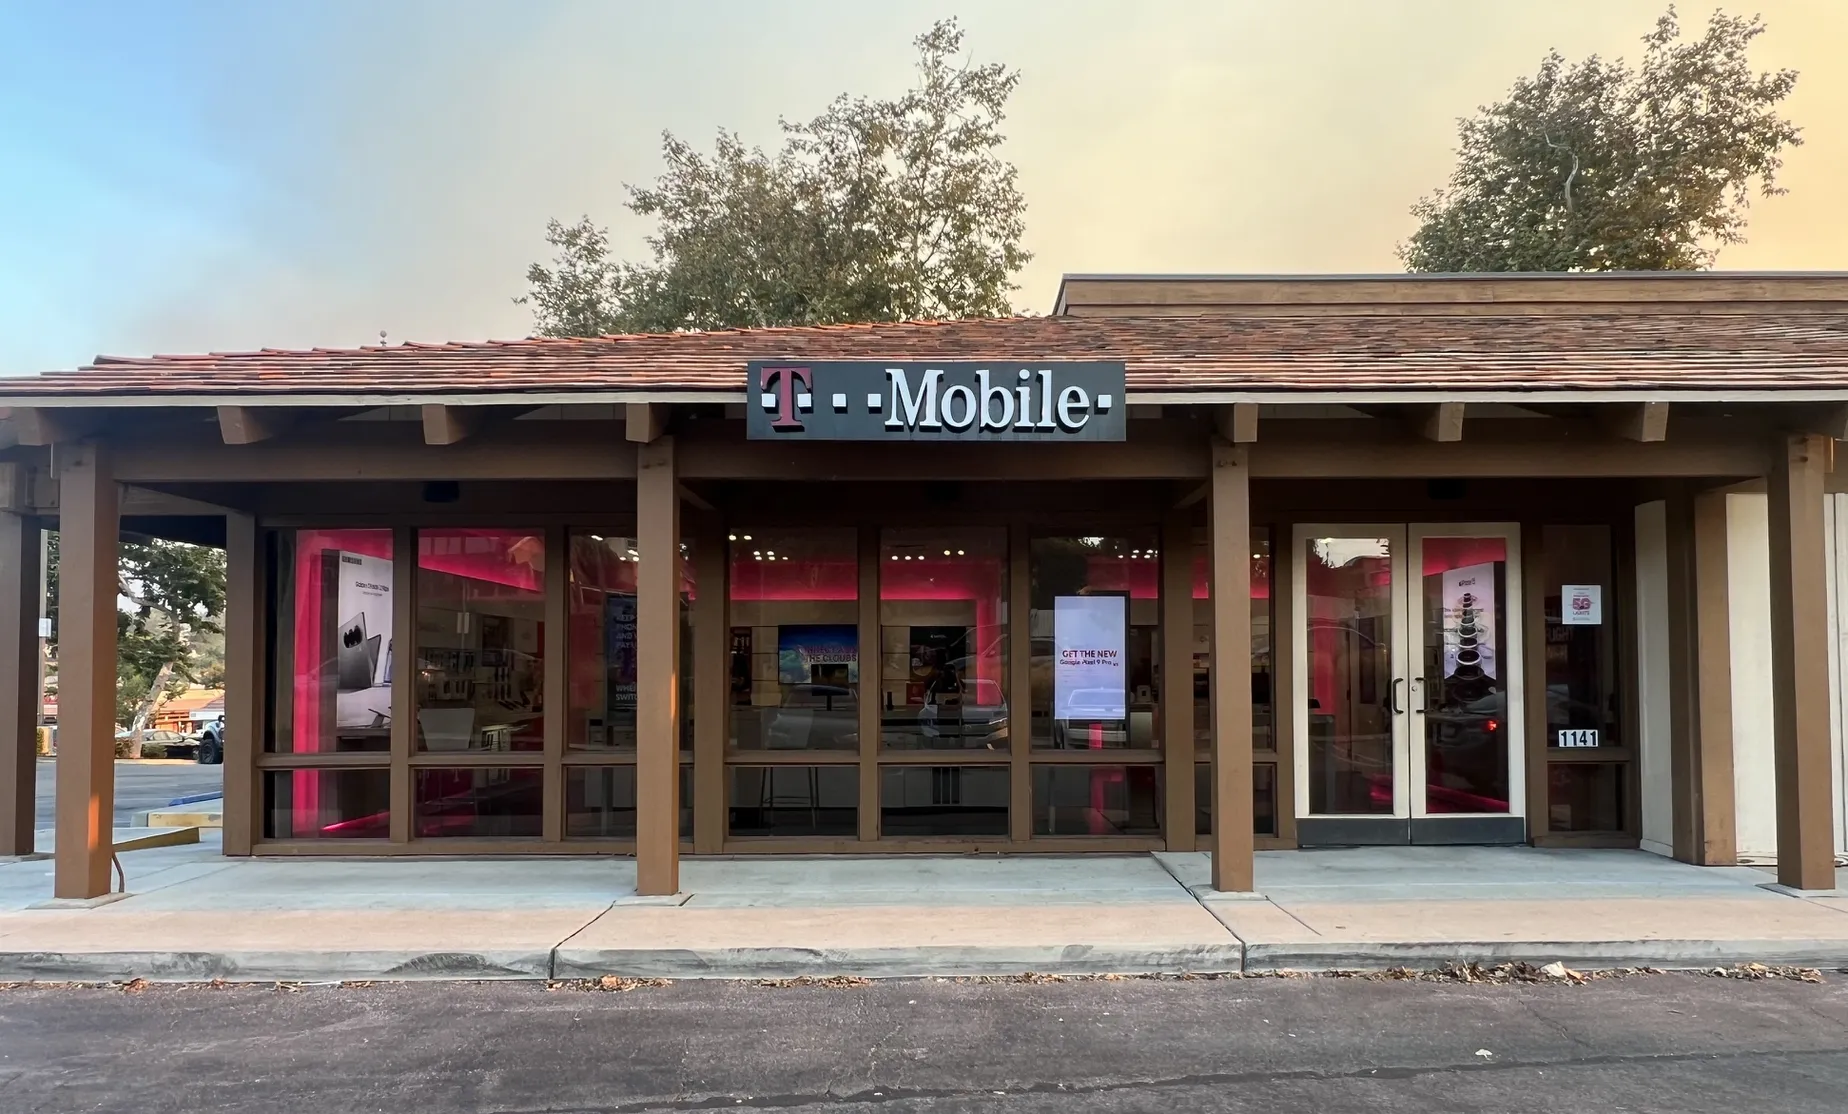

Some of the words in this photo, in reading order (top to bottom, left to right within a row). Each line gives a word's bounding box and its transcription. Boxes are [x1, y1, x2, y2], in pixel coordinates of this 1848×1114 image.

[884, 368, 1090, 429] Mobile
[823, 654, 857, 662] CLOUDS
[1062, 650, 1078, 658] GET
[1080, 650, 1095, 658] THE
[1097, 650, 1117, 658] NEW
[1560, 730, 1597, 747] 1141
